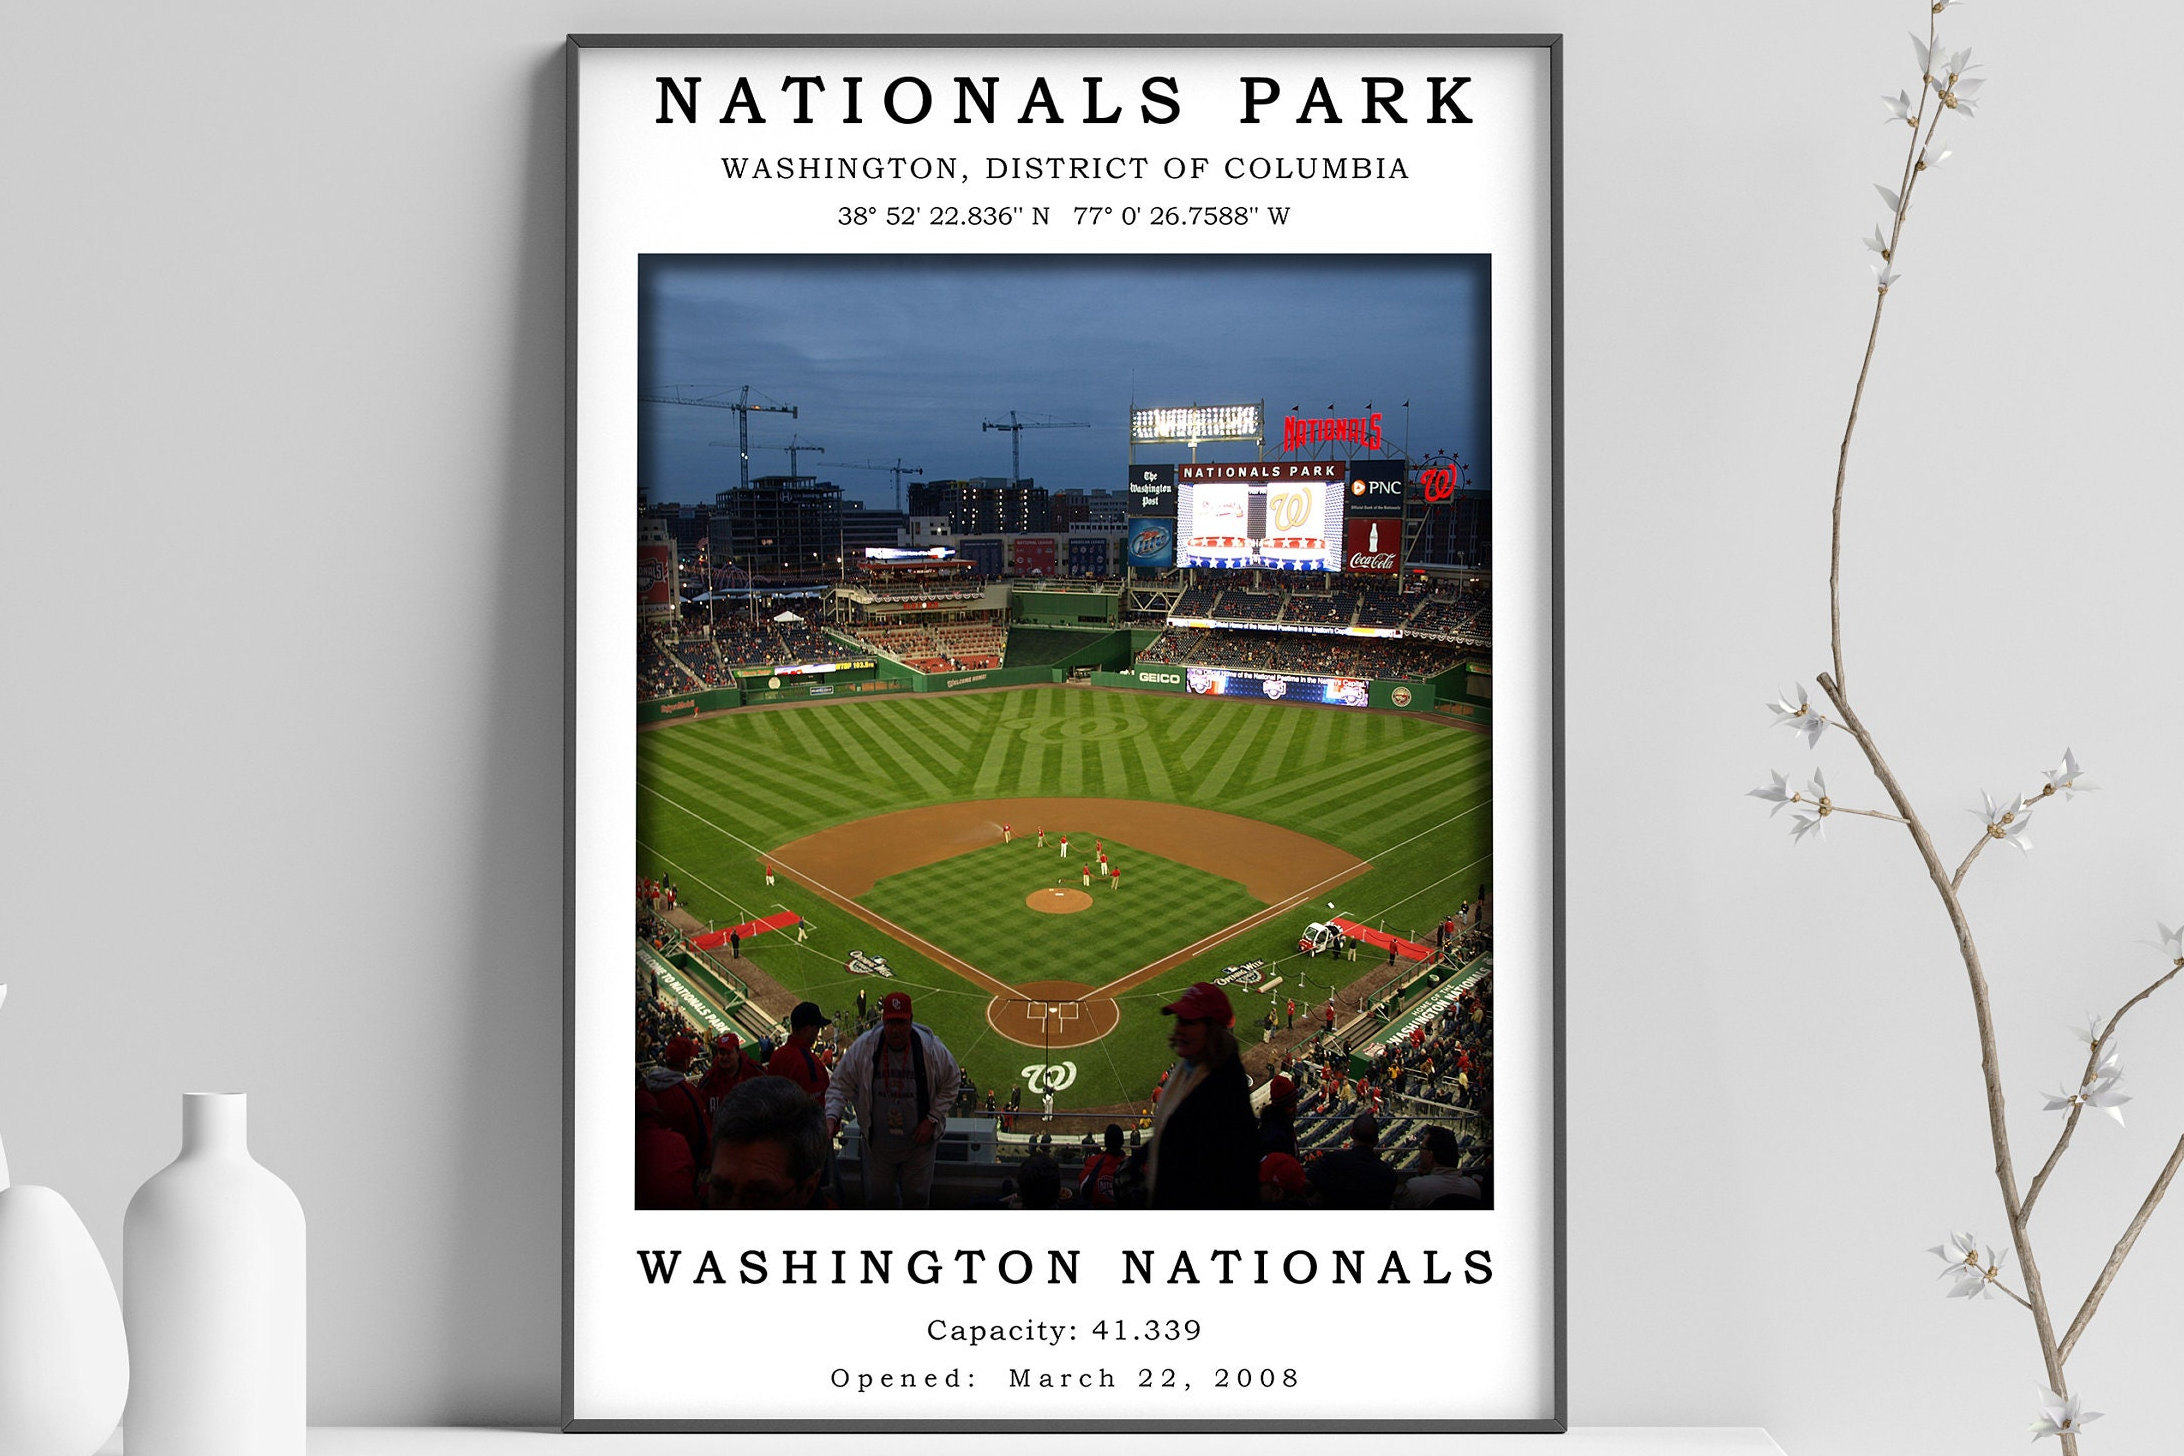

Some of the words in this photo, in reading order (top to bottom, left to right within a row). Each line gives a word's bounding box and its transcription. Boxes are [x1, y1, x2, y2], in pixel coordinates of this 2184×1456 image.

[655, 75, 1181, 125] NATIONALS
[1239, 76, 1474, 124] PARK
[720, 157, 968, 184] WASHINGTON,
[985, 157, 1149, 180] DISTRICT
[1163, 157, 1209, 180] OF
[1224, 157, 1409, 180] COLUMBIA
[838, 206, 877, 226] 38°
[886, 206, 921, 226] 52'
[929, 206, 1023, 226] 22.836"
[1032, 206, 1050, 225] N
[1073, 206, 1113, 225] 77°
[1121, 206, 1141, 226] 0'
[1150, 206, 1259, 226] 26.7588"
[1267, 206, 1291, 225] W
[1283, 413, 1383, 453] NATIONALS
[1143, 471, 1158, 482] The
[1183, 466, 1281, 478] NATIONALS
[1289, 465, 1335, 477] PARK
[1419, 463, 1458, 502] W
[1129, 482, 1172, 495] Washington
[1369, 481, 1401, 495] PNC
[1142, 496, 1159, 508] Post
[1139, 672, 1181, 684] GEICO
[1306, 676, 1317, 684] the
[661, 972, 676, 984] TO
[669, 981, 712, 1017] NATIONALS
[704, 1012, 731, 1034] PARK
[1386, 999, 1448, 1046] WASHINGTON
[1445, 967, 1491, 1004] NATIONALS
[1411, 1001, 1433, 1017] HOME
[1430, 992, 1442, 1002] OF
[1439, 984, 1456, 997] THE
[636, 1249, 1081, 1285] WASHINGTON
[1121, 1249, 1493, 1285] NATIONALS
[927, 1318, 1076, 1347] Capacity:
[1092, 1319, 1201, 1341] 41.339
[831, 1368, 974, 1393] Opened:
[1009, 1368, 1115, 1388] March
[1138, 1368, 1191, 1391] 22,
[1214, 1368, 1298, 1388] 2008
